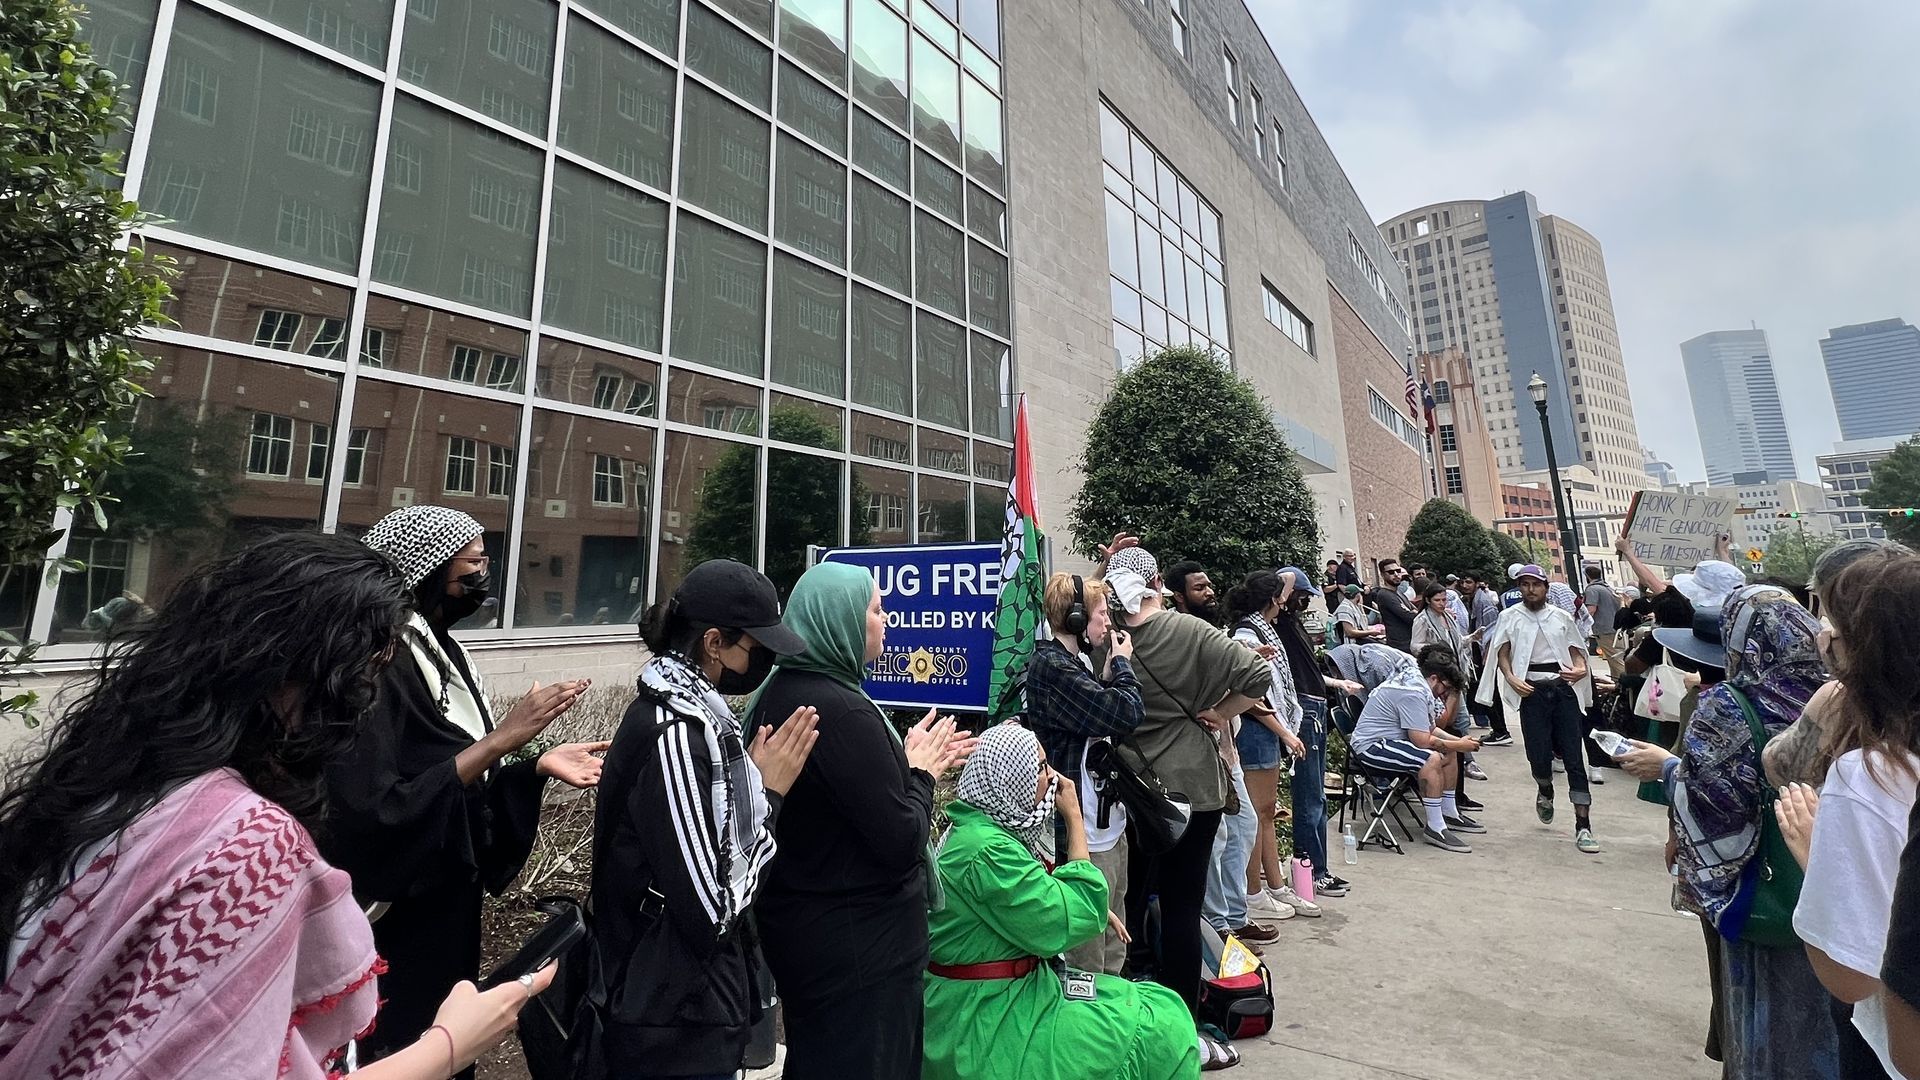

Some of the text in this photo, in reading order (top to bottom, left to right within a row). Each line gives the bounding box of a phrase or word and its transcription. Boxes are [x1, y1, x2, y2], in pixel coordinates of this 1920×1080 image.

[1640, 494, 1729, 518] HONK IF YOU
[1633, 515, 1723, 537] HATE GENOCIDE
[1632, 541, 1712, 561] REE PALESTINE
[873, 562, 1001, 597] UG FRE
[1506, 591, 1523, 600] PRES
[886, 611, 996, 629] OLLED BY K
[886, 645, 968, 654] RRIS COUNTY
[932, 678, 967, 686] OFFICE
